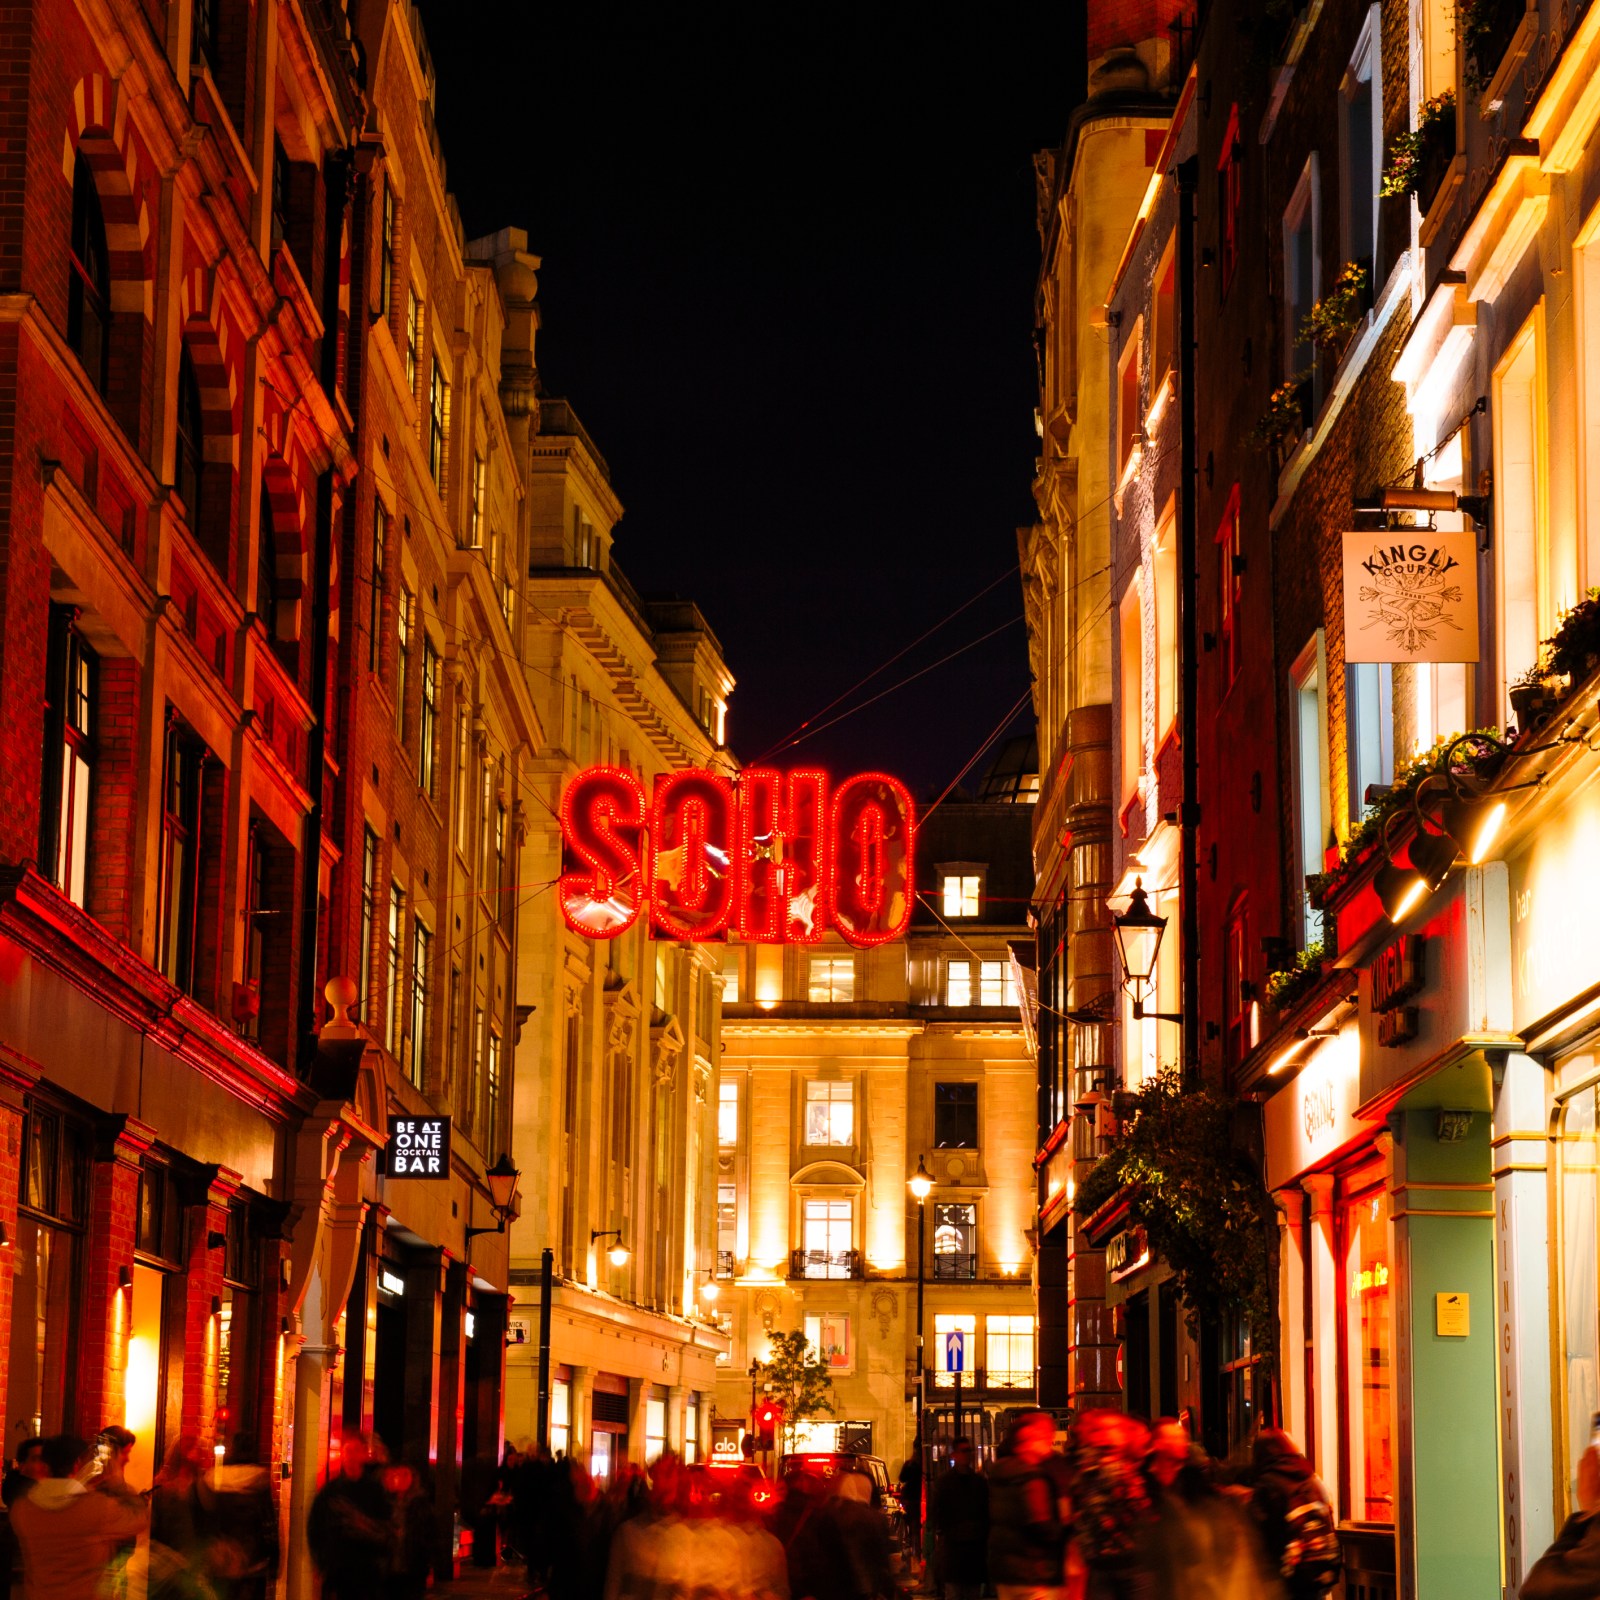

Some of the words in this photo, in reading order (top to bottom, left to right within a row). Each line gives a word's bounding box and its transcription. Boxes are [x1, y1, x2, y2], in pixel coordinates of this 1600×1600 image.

[1361, 544, 1460, 577] KINGLY
[1383, 564, 1437, 577] COURT
[560, 765, 916, 944] SOHO
[1516, 888, 1531, 923] bar
[396, 1121, 415, 1134] BE
[421, 1121, 442, 1134] AT
[396, 1134, 442, 1149] ONE
[396, 1149, 440, 1157] COCKTAIL
[394, 1156, 440, 1173] BAR
[1501, 1198, 1512, 1441] KINGLY
[715, 1437, 736, 1452] alo
